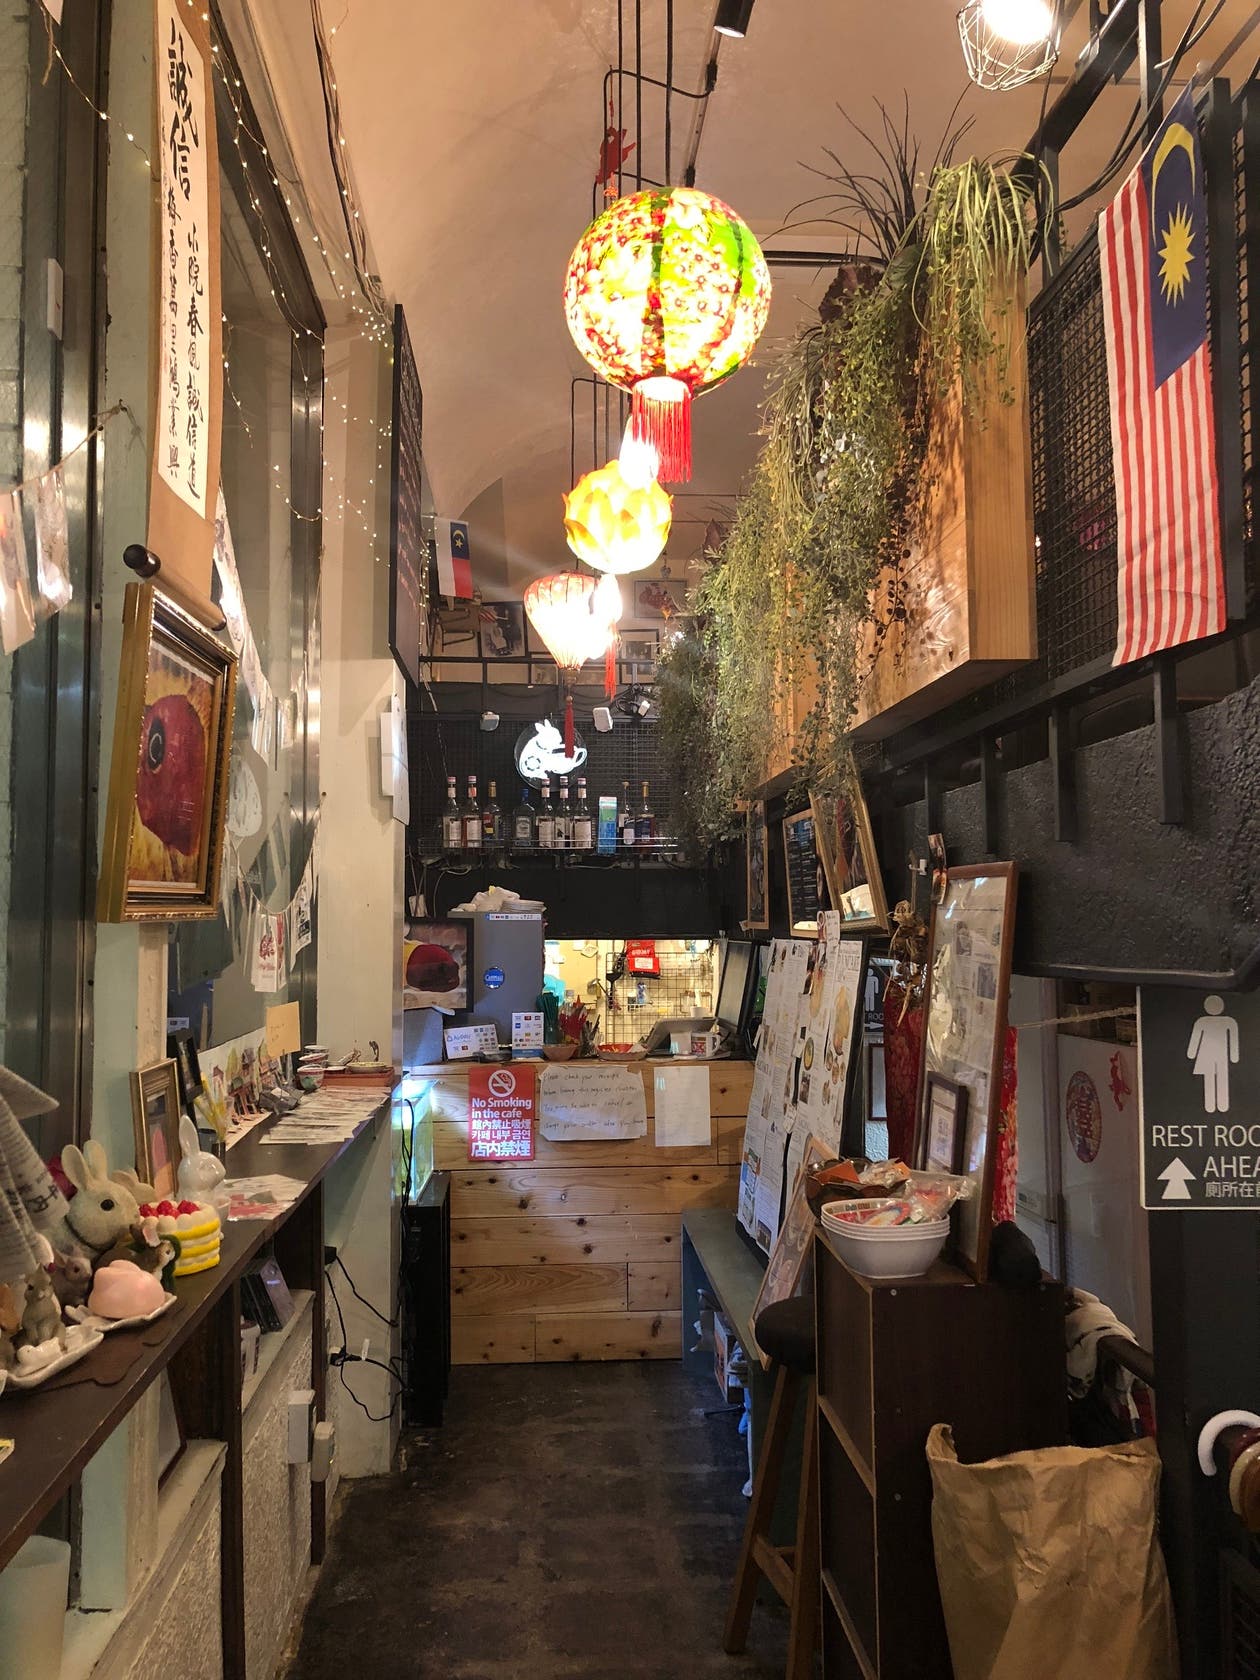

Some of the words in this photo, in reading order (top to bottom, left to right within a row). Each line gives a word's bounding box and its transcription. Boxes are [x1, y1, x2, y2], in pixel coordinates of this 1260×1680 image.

[472, 1097, 486, 1108] No
[487, 1097, 532, 1110] Smoking
[472, 1108, 481, 1118] in
[482, 1108, 500, 1118] the
[501, 1107, 522, 1118] cafe
[471, 1130, 490, 1141] 카페
[492, 1130, 511, 1140] 내부
[512, 1129, 531, 1140] 금연
[1152, 1125, 1208, 1147] REST
[1205, 1180, 1260, 1198] 廁所在
